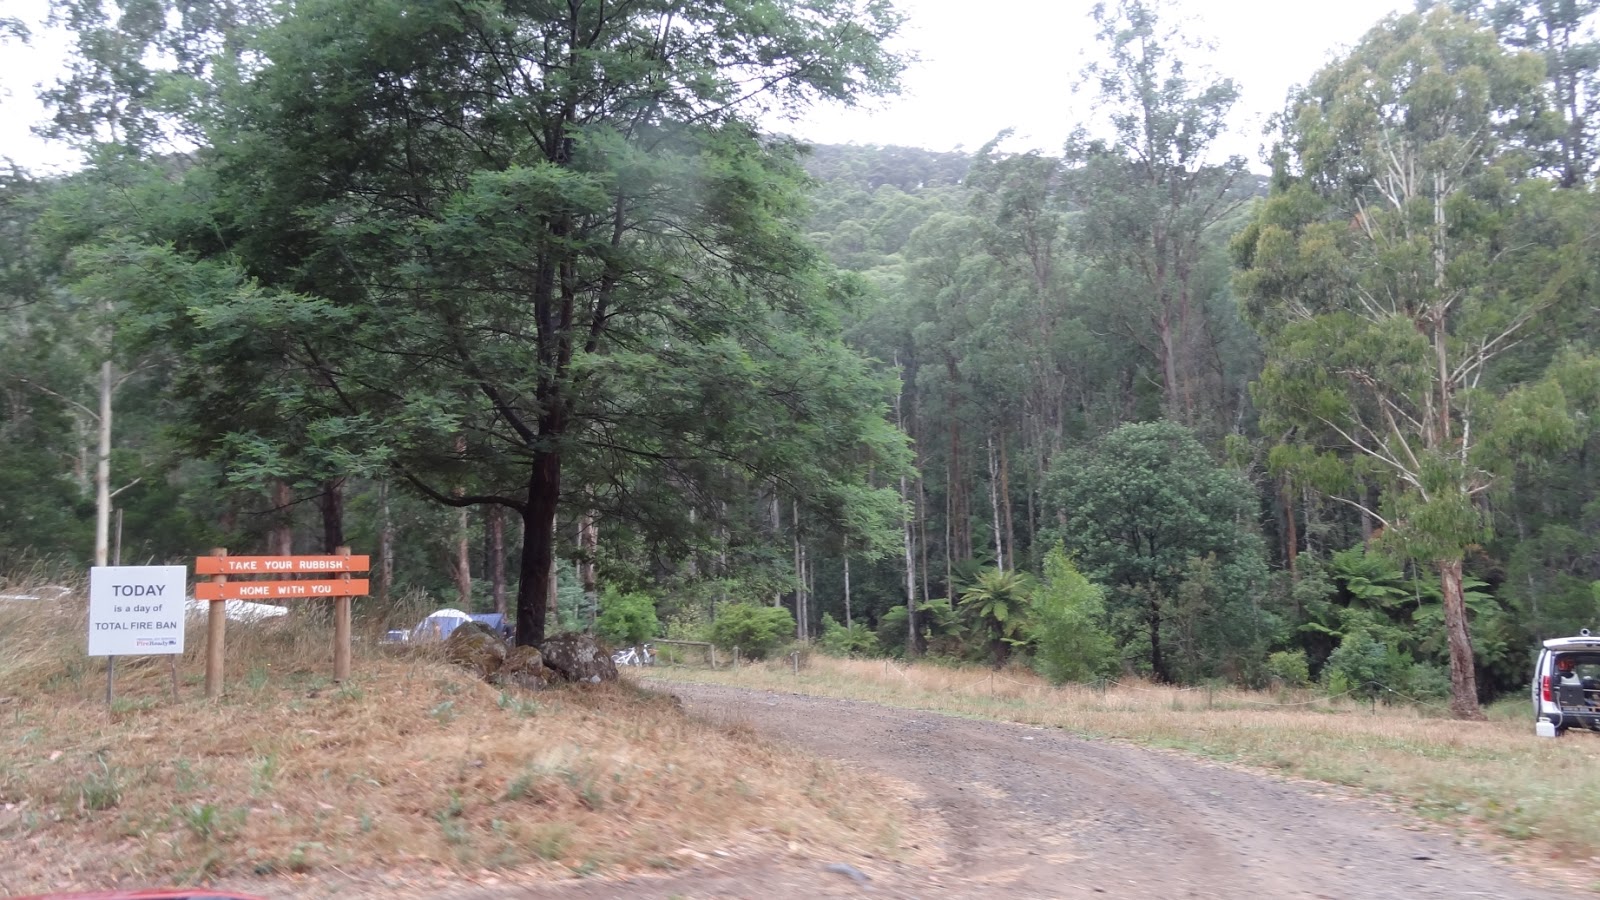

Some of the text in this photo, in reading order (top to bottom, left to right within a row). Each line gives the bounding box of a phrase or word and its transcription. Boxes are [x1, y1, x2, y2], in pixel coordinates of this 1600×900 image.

[229, 560, 343, 570] TAKE YOUR RUBBISH
[112, 585, 165, 596] TODAY
[239, 585, 332, 595] HOME WITH YOU
[133, 605, 150, 613] day
[152, 604, 162, 612] of
[95, 621, 177, 630] TOTAL FIRE BAN
